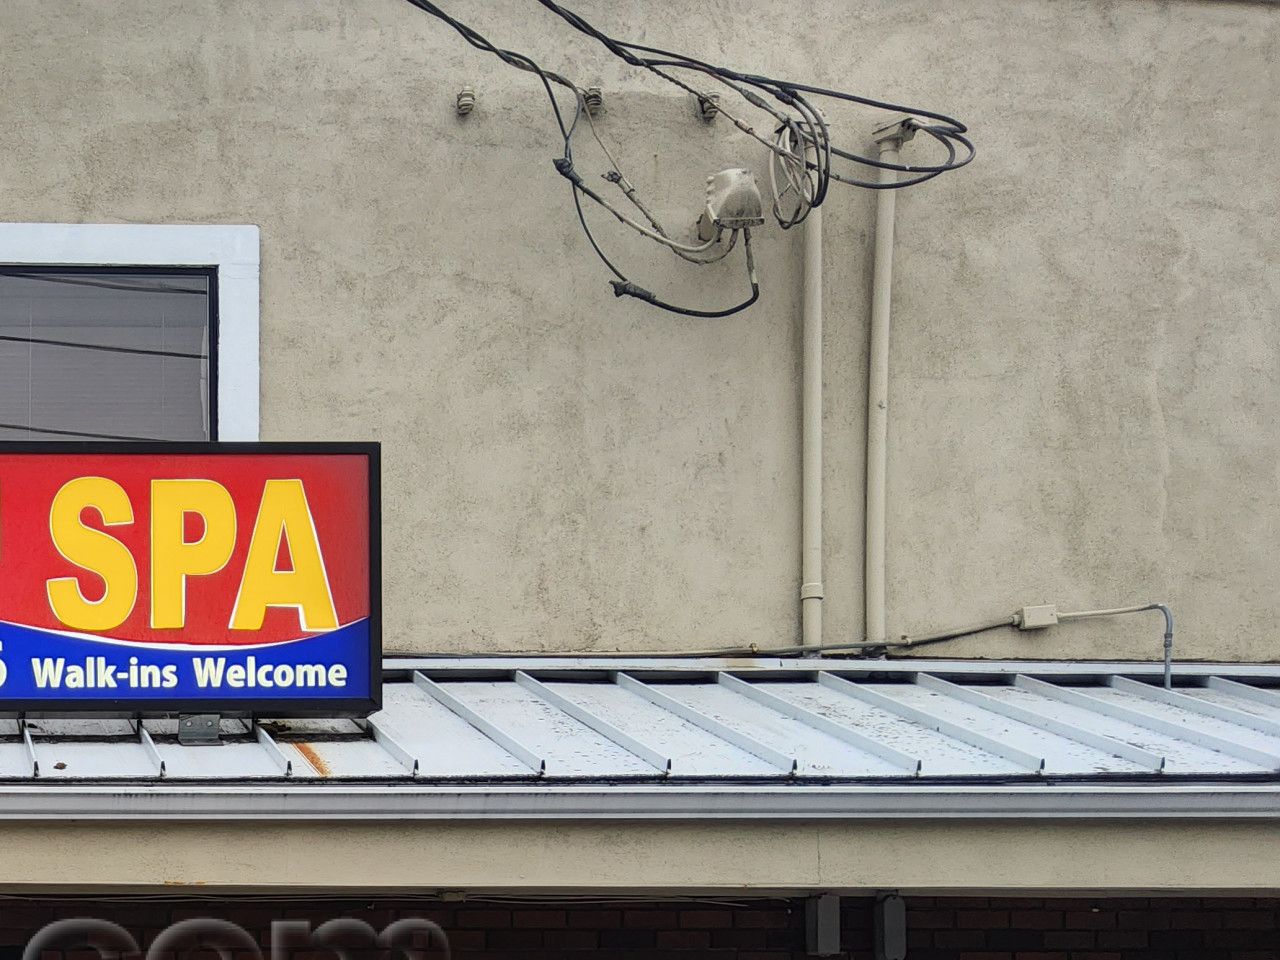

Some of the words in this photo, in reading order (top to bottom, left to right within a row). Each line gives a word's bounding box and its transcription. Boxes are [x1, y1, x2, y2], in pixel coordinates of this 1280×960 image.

[45, 475, 341, 632] SPA
[31, 655, 179, 690] Walk-ins
[193, 655, 348, 690] Welcome
